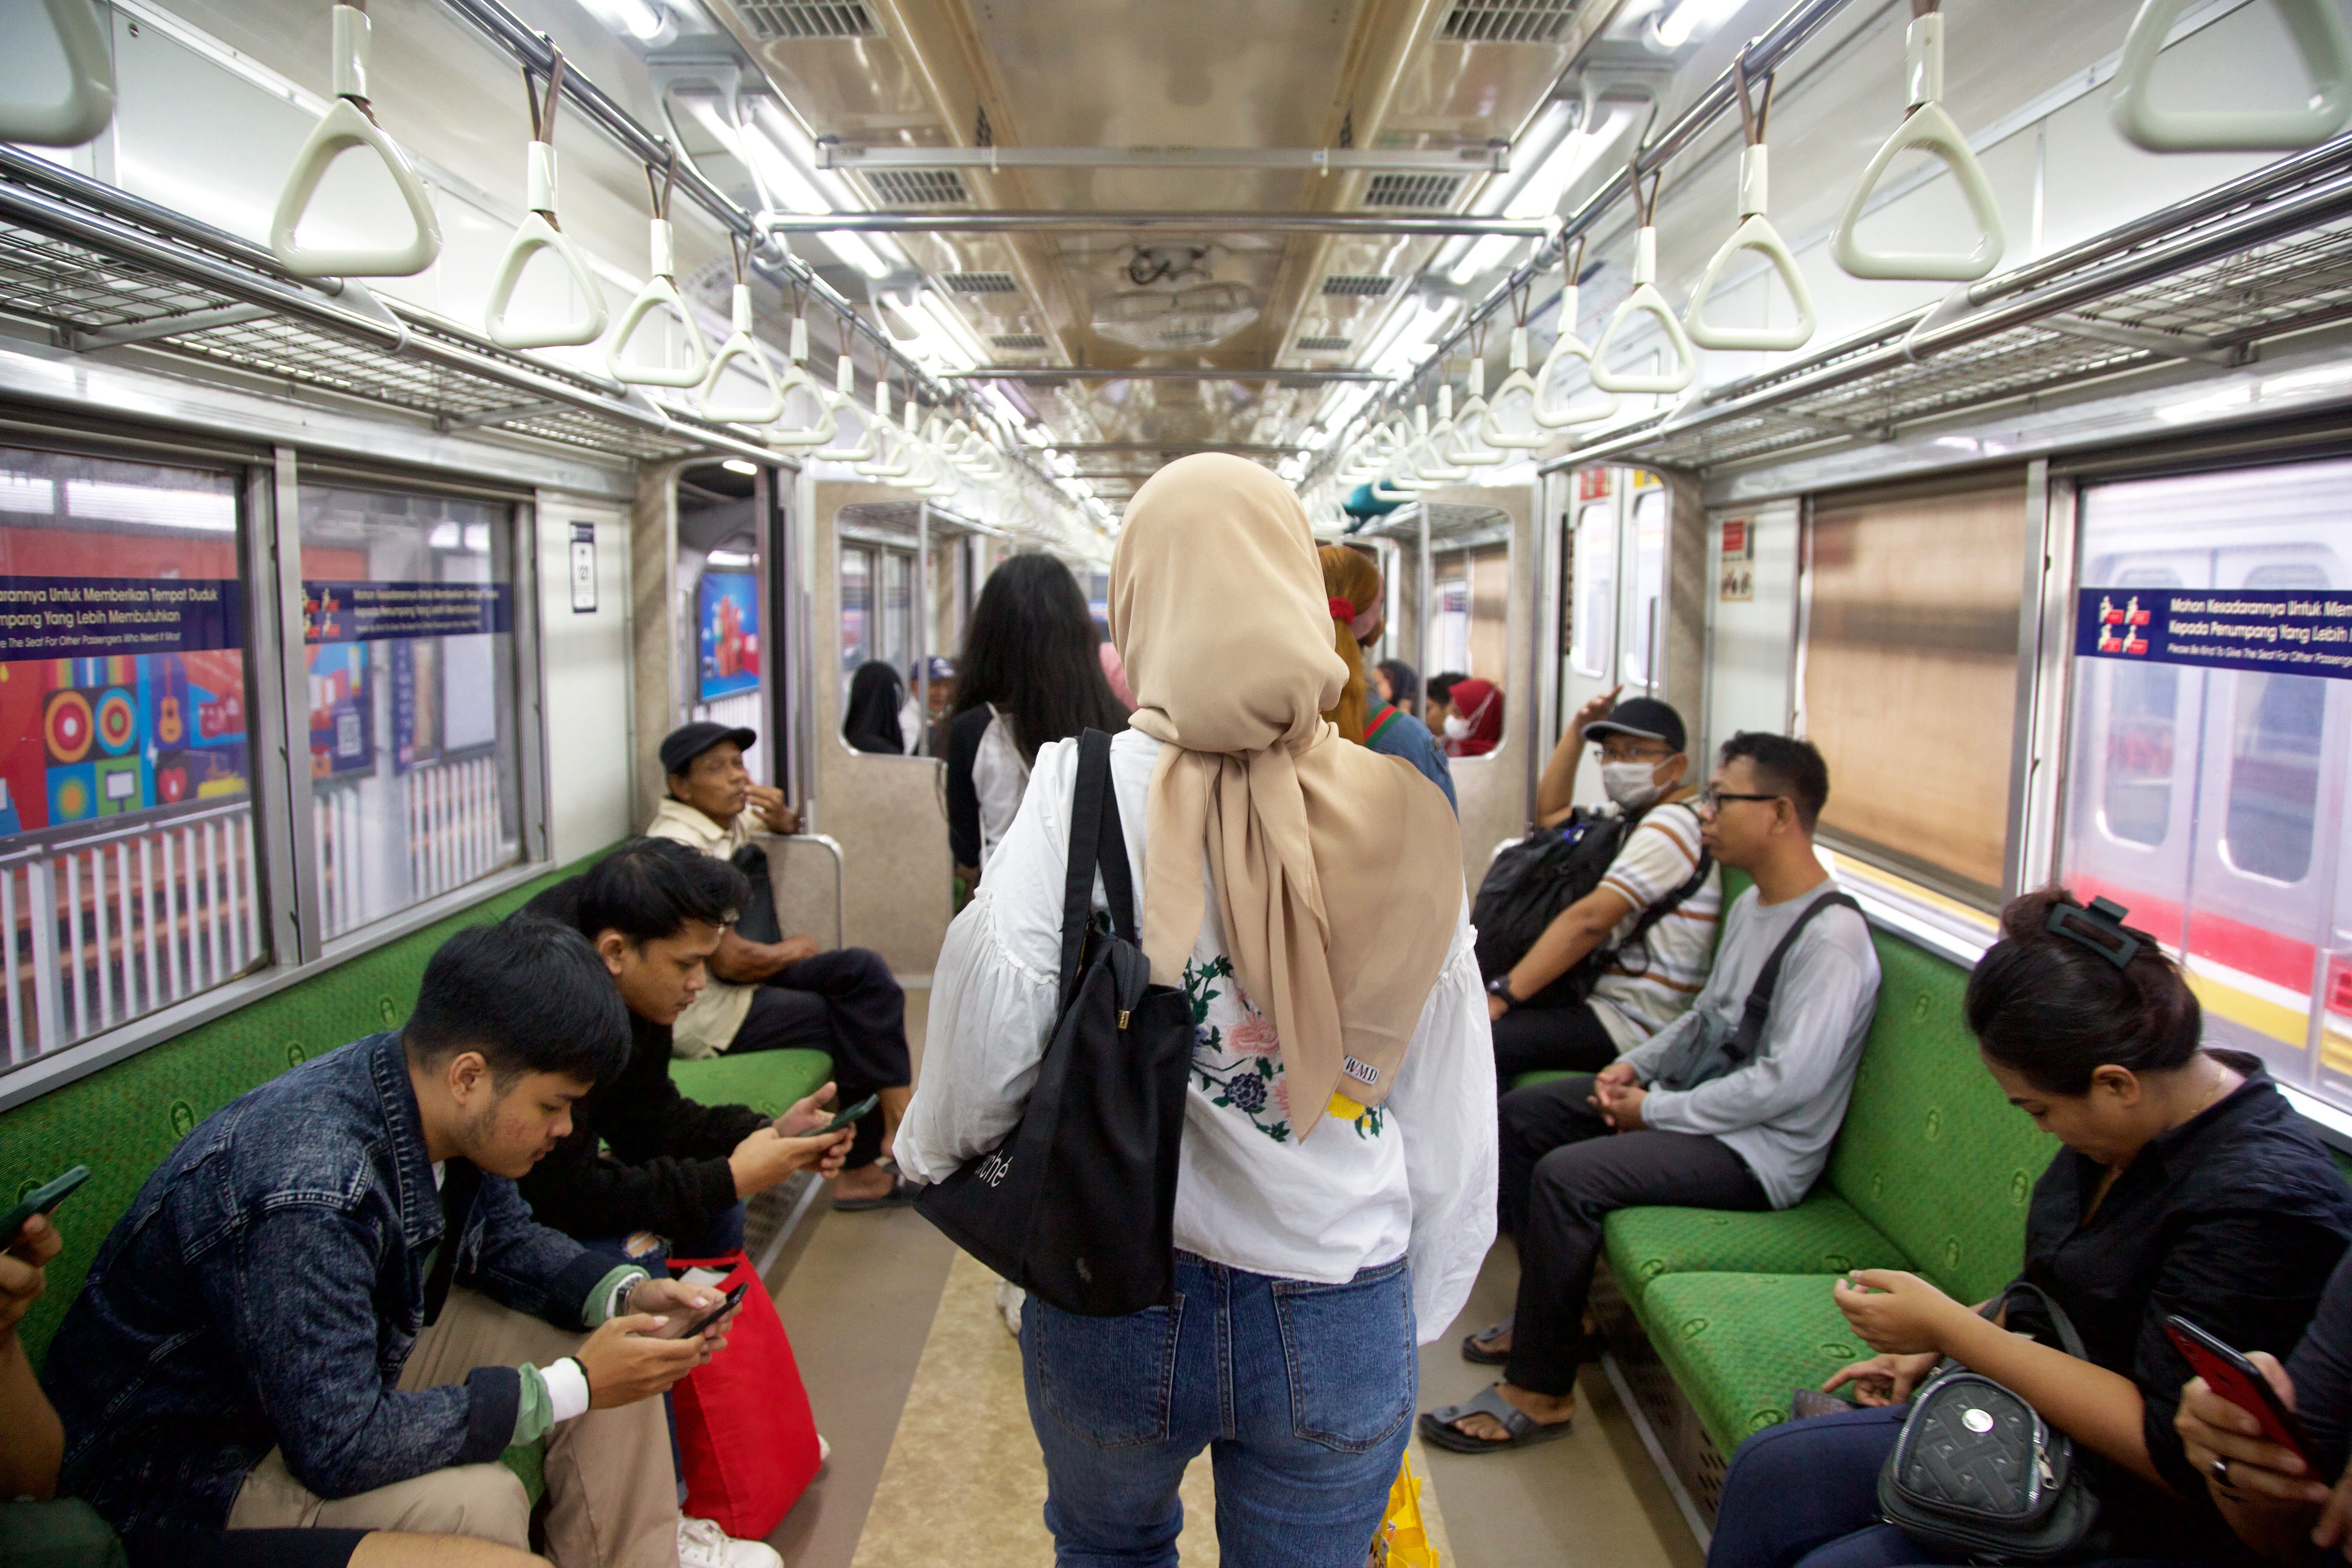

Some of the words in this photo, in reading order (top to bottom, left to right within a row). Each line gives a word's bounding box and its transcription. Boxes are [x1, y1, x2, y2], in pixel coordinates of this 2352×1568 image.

[49, 588, 82, 602] Untuk
[83, 587, 149, 602] Memberikan
[150, 588, 187, 604] Tempat
[187, 587, 218, 602] Duduk
[2170, 597, 2206, 613] Mohon
[2207, 598, 2286, 618] Kesadarannya
[2287, 600, 2323, 617] Untuk
[43, 610, 74, 628] Yang
[76, 610, 107, 624] Lebih
[108, 609, 181, 624] Membutuhkan
[2168, 619, 2209, 637] Kepada
[2210, 621, 2278, 643] Penumpang
[2278, 624, 2311, 644] Yang
[2311, 625, 2348, 642] Lebih
